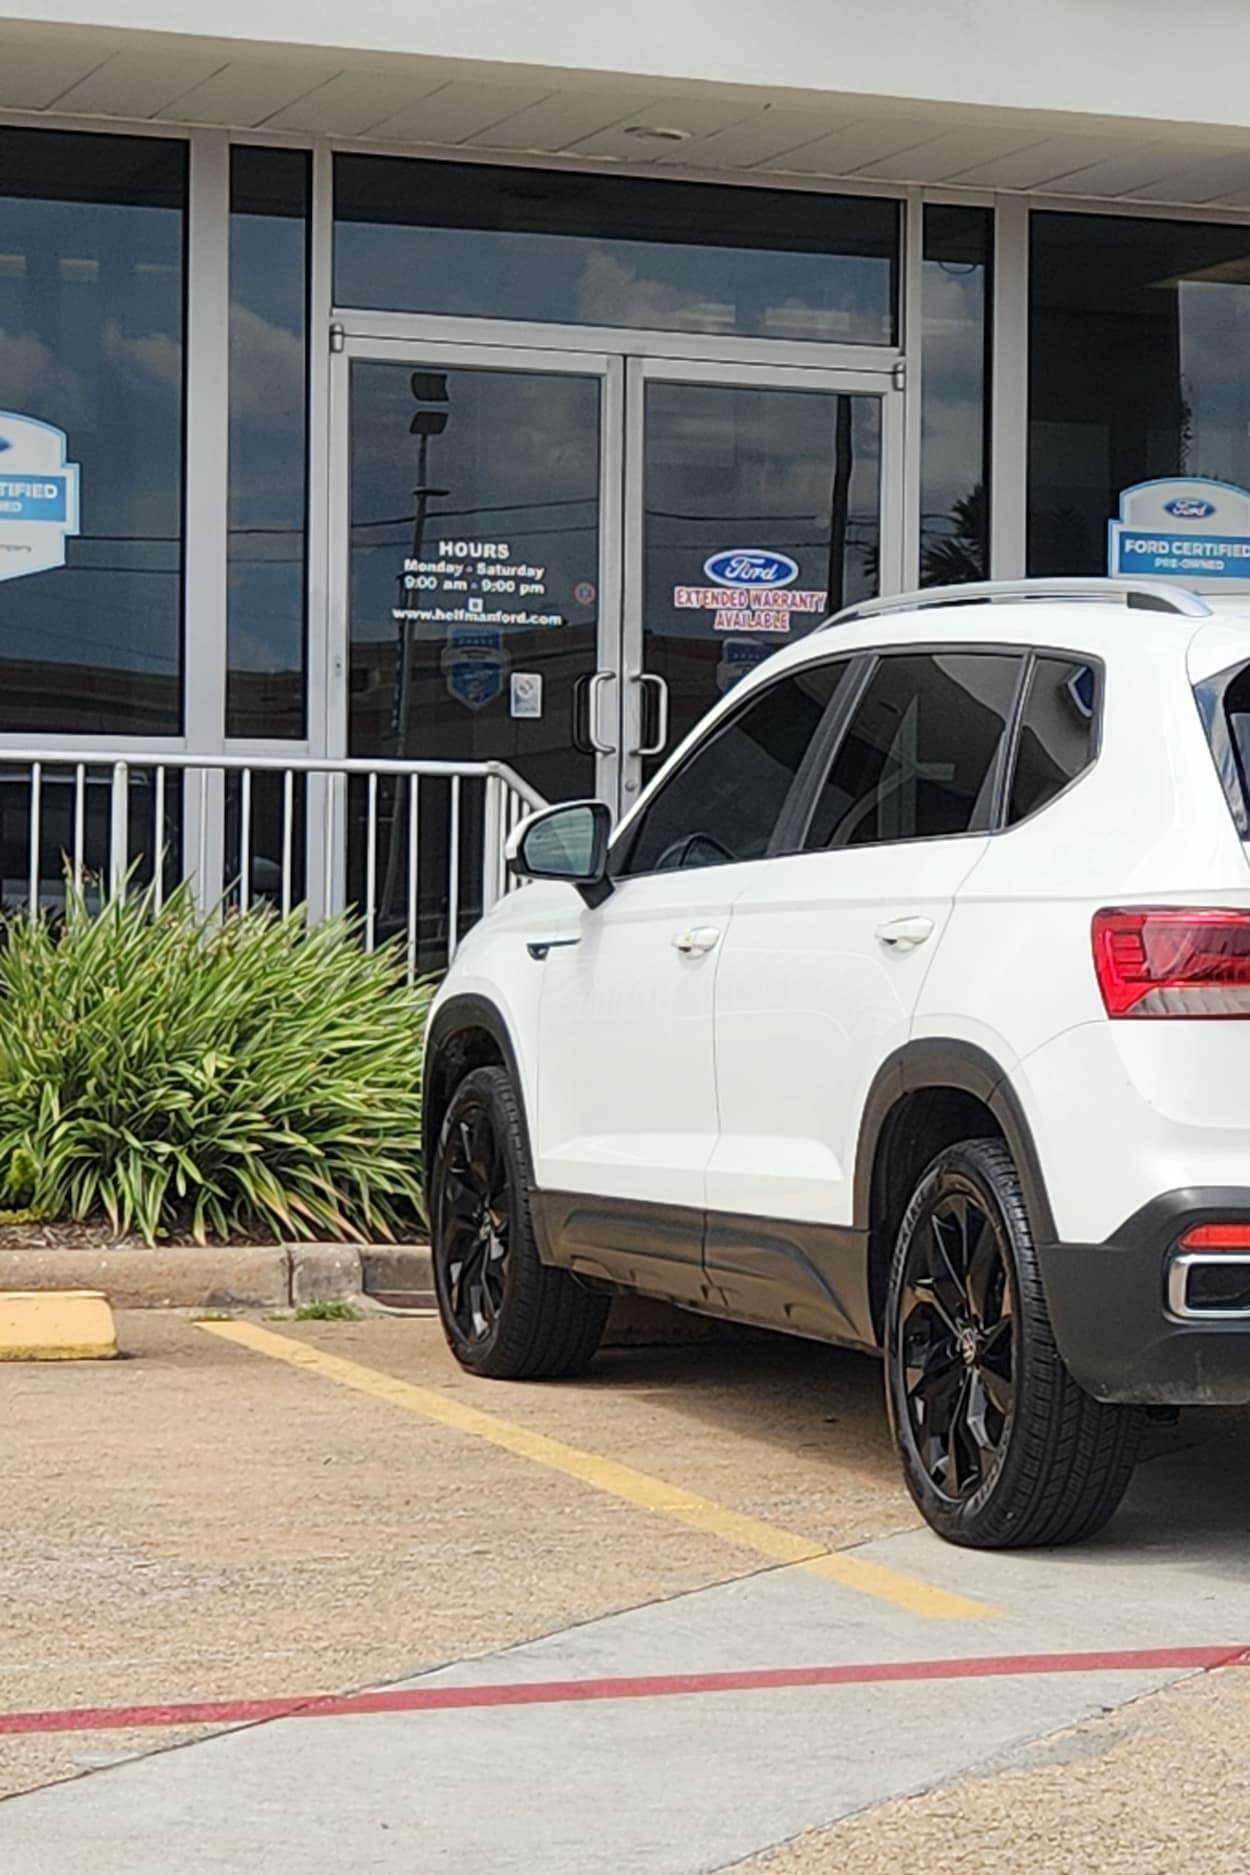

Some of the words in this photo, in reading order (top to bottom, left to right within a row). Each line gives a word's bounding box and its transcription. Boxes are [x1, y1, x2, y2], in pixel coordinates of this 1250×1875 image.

[439, 541, 510, 559] HOURS
[1125, 538, 1169, 555] FORD
[404, 559, 464, 576] Monday
[476, 562, 545, 581] Saturday
[724, 556, 779, 581] Ford
[1154, 557, 1225, 571] PRE-OWNED
[404, 576, 438, 590] 9:00
[442, 579, 468, 591] am
[481, 579, 516, 593] 9:00
[519, 583, 545, 597] pm
[675, 587, 748, 609] EXTENDED
[750, 589, 827, 612] WARRANTY
[392, 607, 563, 626] www.helfmanford.com
[714, 610, 790, 632] AVAILABLE
